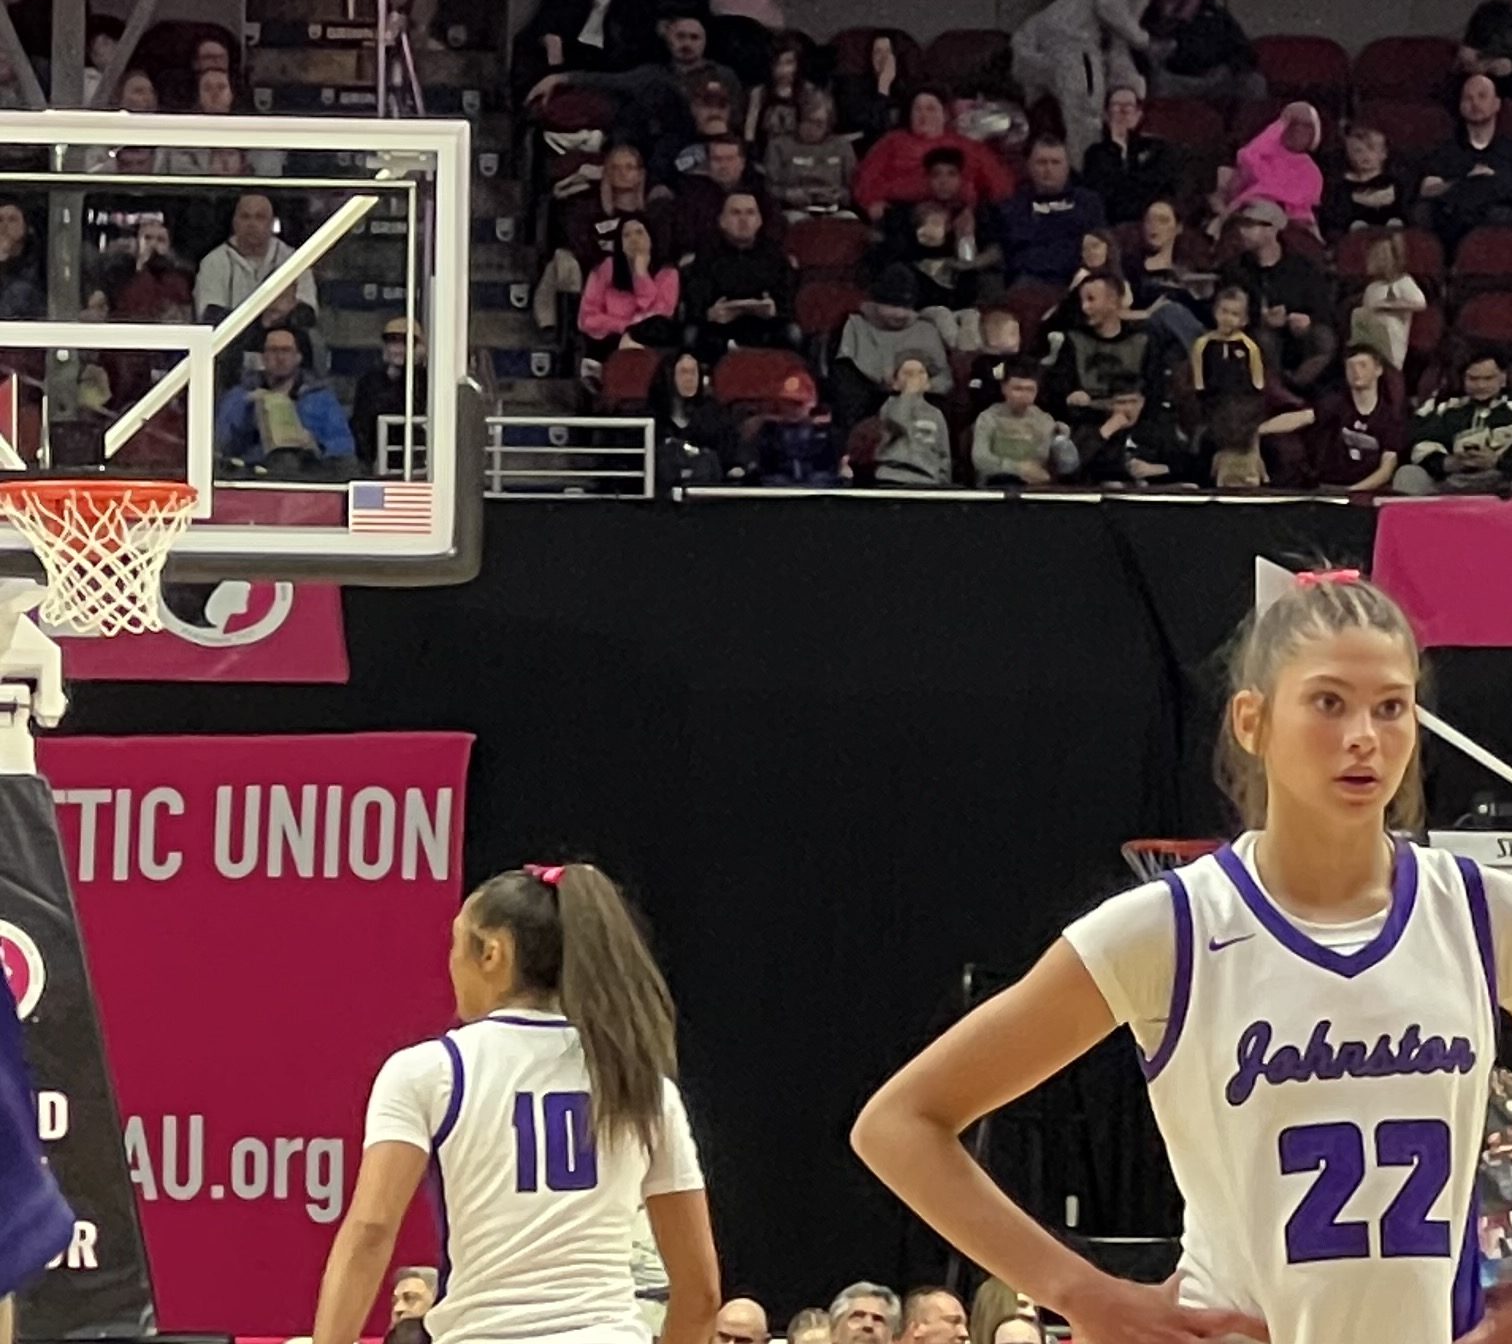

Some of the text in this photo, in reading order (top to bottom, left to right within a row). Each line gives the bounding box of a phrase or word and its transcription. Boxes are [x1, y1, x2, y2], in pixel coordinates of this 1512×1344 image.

[52, 784, 453, 883] TIC UNION
[1225, 1020, 1476, 1106] Johnston
[512, 1091, 599, 1193] 10
[1278, 1118, 1453, 1265] 22
